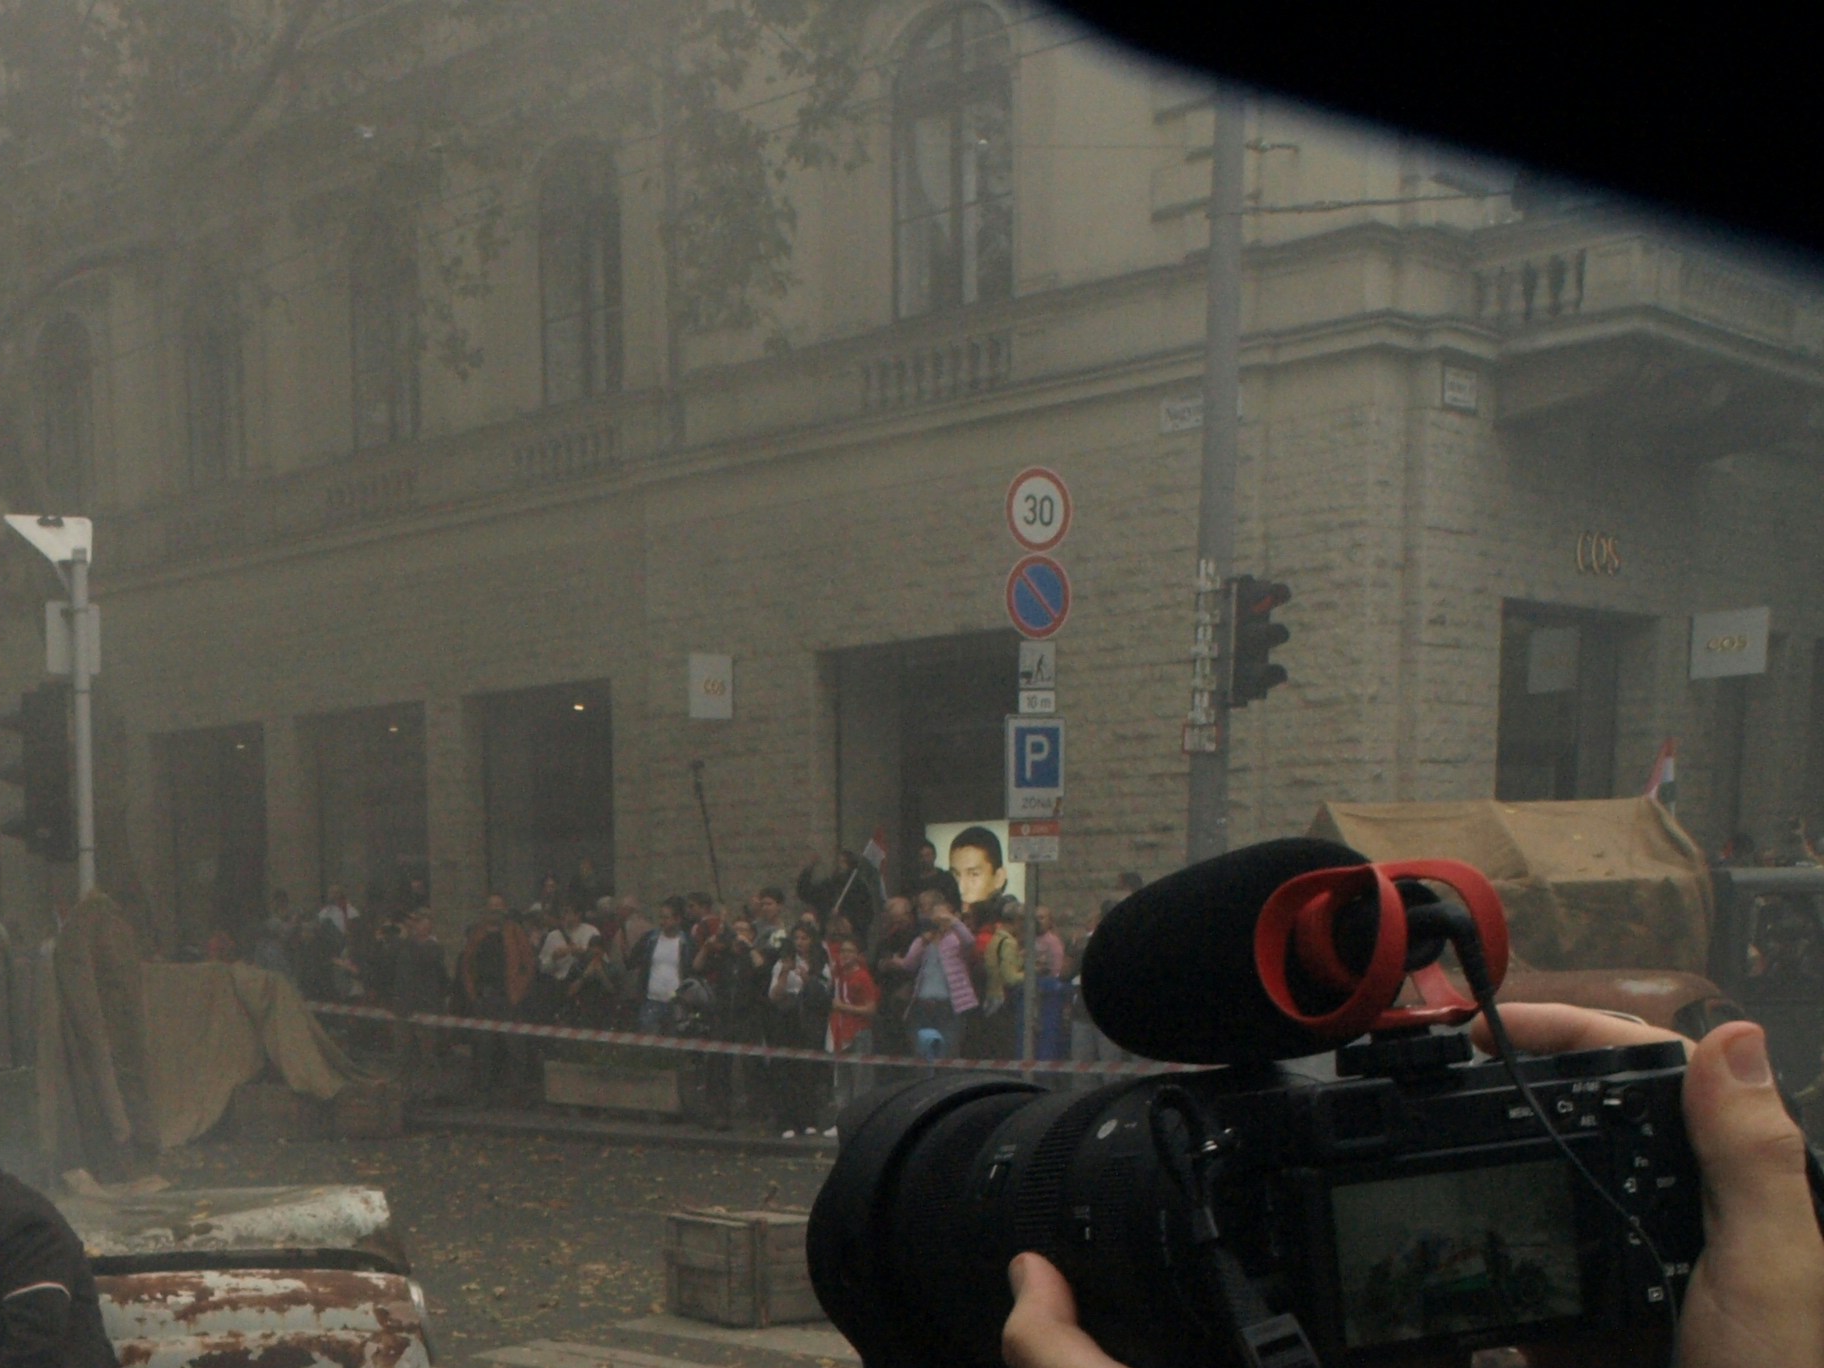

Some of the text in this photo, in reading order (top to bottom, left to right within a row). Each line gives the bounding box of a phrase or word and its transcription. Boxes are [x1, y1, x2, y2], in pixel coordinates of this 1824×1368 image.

[1023, 494, 1054, 526] 30
[1578, 530, 1621, 576] COS
[1707, 636, 1747, 652] COS
[1025, 734, 1050, 781] P
